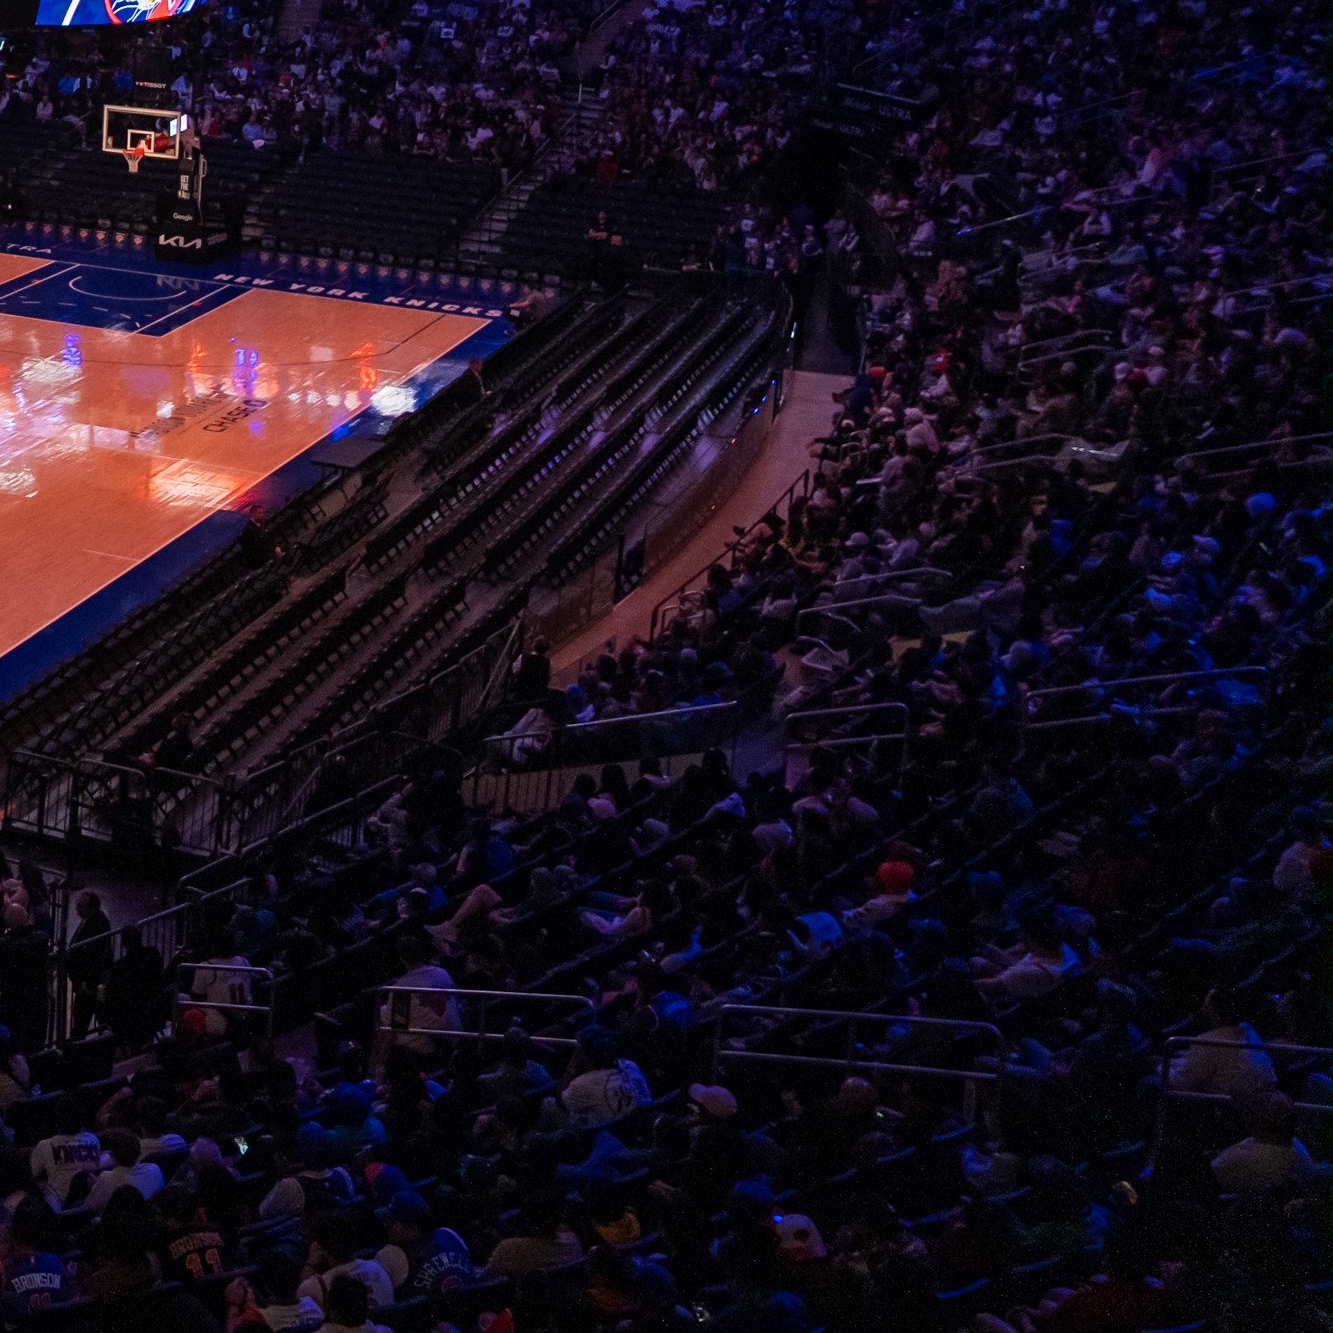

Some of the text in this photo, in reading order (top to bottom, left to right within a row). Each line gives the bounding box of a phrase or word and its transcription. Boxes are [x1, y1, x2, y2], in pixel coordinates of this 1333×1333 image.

[173, 212, 192, 221] Google
[159, 234, 202, 249] KIA
[214, 274, 504, 317] NEW YORK KNICKS
[203, 406, 258, 433] CHASE
[11, 1272, 61, 1294] BRUNSON
